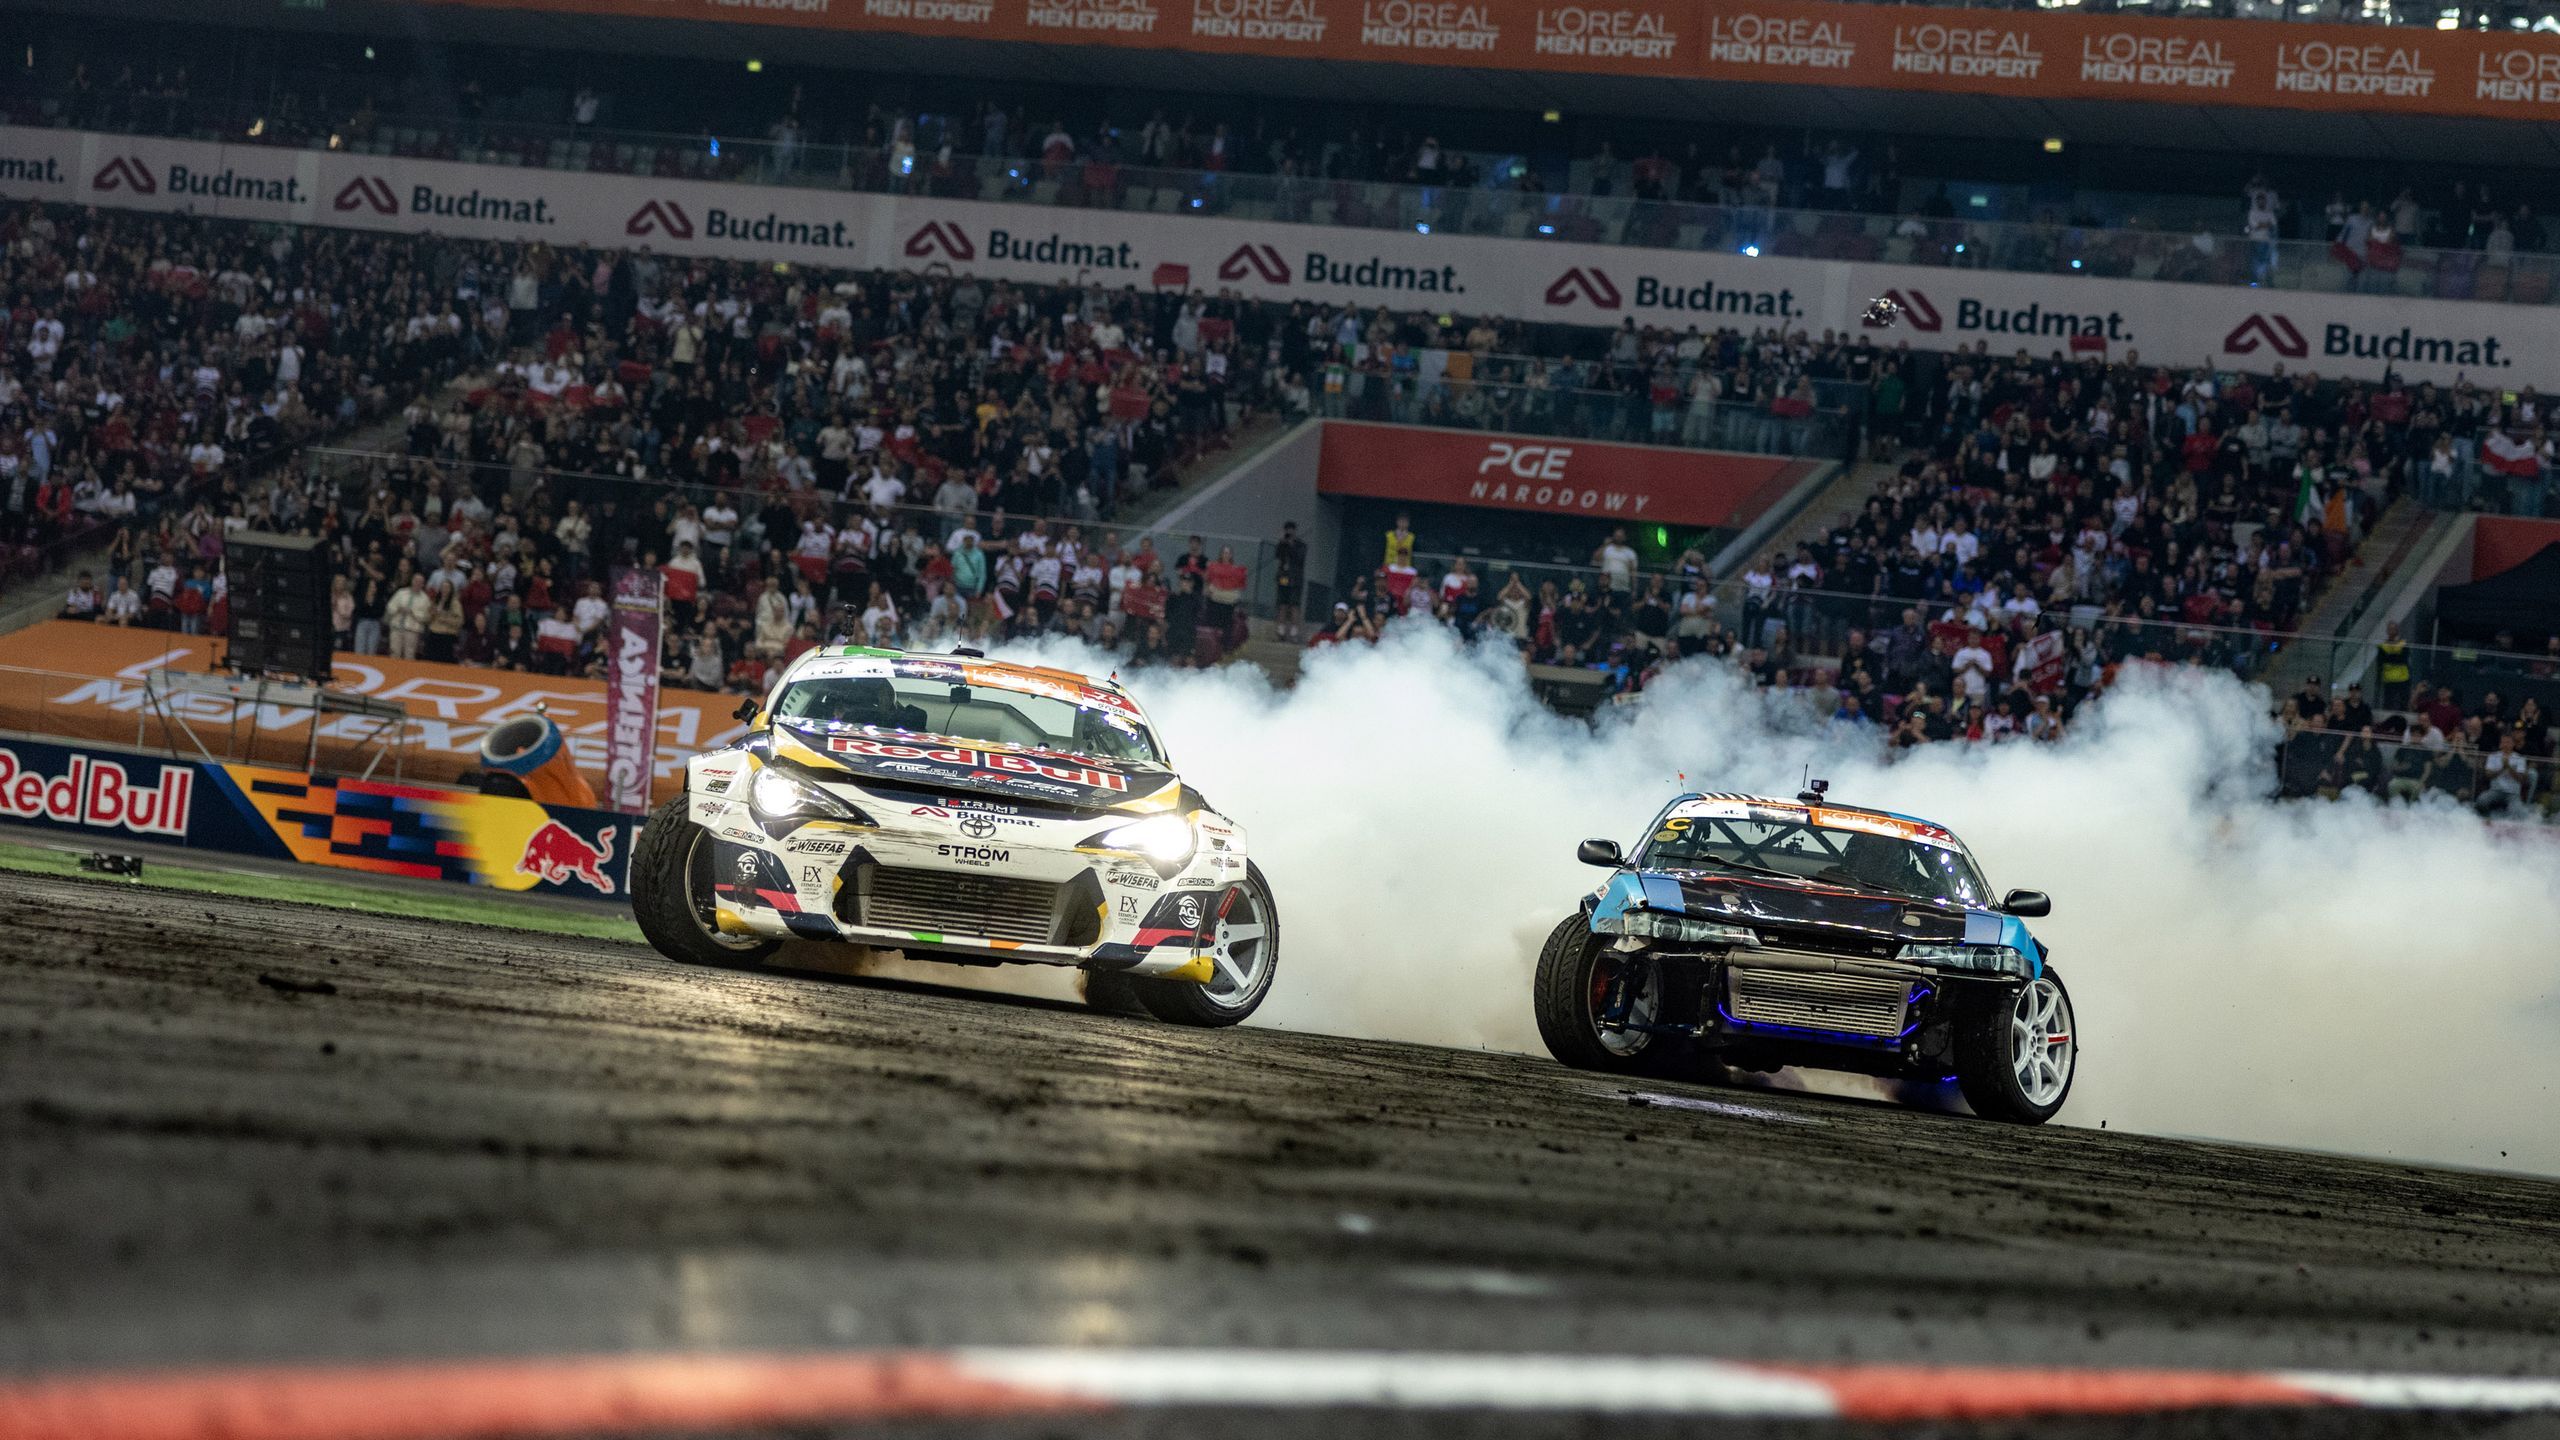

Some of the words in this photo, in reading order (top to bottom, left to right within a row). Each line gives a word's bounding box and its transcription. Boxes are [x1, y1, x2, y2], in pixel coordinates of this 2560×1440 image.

[864, 0, 910, 17] MEN
[913, 2, 993, 22] EXPERT
[1026, 8, 1073, 27] MEN
[1075, 11, 1158, 32] EXPERT
[1191, 18, 1241, 36] MEN
[1243, 20, 1327, 41] EXPERT
[1361, 26, 1411, 46] MEN
[1414, 29, 1500, 50] EXPERT
[1535, 34, 1585, 57] MEN
[1588, 38, 1677, 60] EXPERT
[1709, 43, 1761, 64] MEN
[1764, 46, 1855, 69] EXPERT
[1892, 51, 1946, 73] MEN
[1949, 55, 2042, 79] EXPERT
[2080, 59, 2137, 82] MEN
[2139, 64, 2236, 88] EXPERT
[2275, 69, 2332, 93] MEN
[2334, 73, 2435, 97] EXPERT
[2476, 79, 2534, 102] MEN
[166, 165, 306, 202] Budmat.
[411, 185, 555, 224] Budmat.
[705, 209, 854, 247] Budmat.
[988, 230, 1139, 270] Budmat.
[1304, 253, 1465, 294] Budmat.
[1636, 276, 1803, 317] Budmat.
[1957, 298, 2132, 341] Budmat.
[2323, 323, 2510, 366] Budmat.
[1478, 442, 1572, 481] PGE
[1470, 481, 1650, 514] NARODOWY
[827, 737, 978, 767] Red
[984, 751, 1128, 793] Bull
[957, 811, 1040, 828] Budmat.
[797, 840, 846, 853] WISEFAB
[937, 844, 1010, 862] STRÖM
[954, 858, 991, 867] WHEELS
[1119, 872, 1160, 889] WISEFAB
[1179, 904, 1201, 919] ACL
